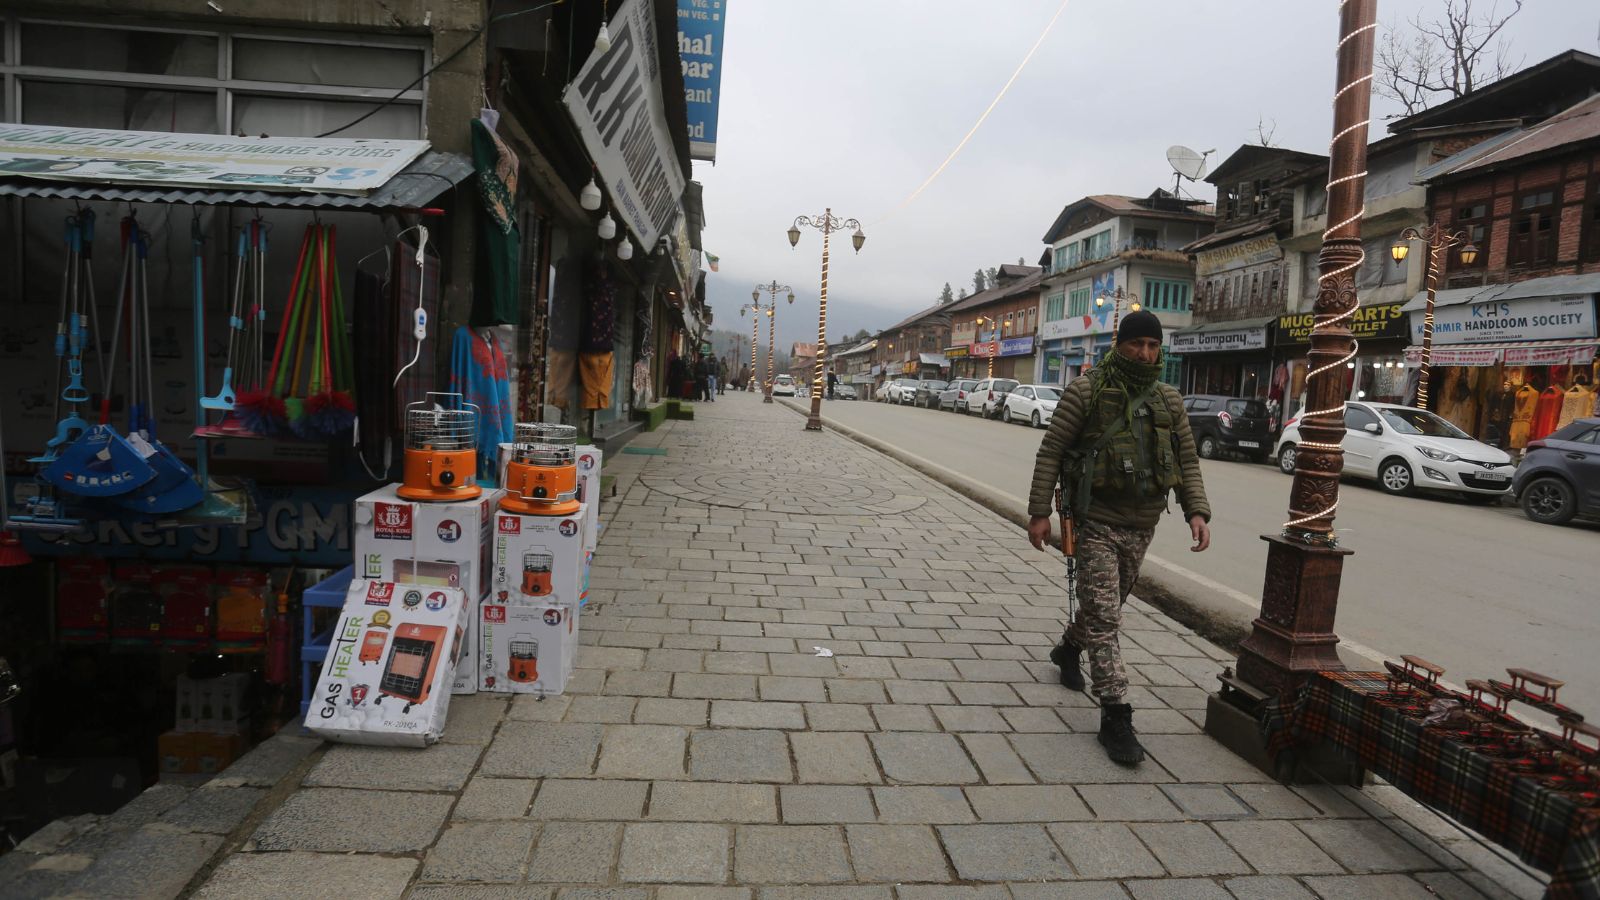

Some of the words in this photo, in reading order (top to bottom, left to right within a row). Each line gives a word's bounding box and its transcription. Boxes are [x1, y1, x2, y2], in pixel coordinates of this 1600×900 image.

[677, 9, 689, 18] ON
[677, 31, 713, 56] hal
[684, 87, 712, 104] ant
[0, 127, 169, 148] OCKERY
[174, 142, 314, 155] HARDWARE
[317, 147, 401, 158] STORE
[638, 155, 675, 233] FACTORY
[1245, 235, 1277, 253] SONS
[1280, 314, 1314, 329] MUG
[1289, 327, 1314, 337] FACT
[1349, 320, 1388, 332] UTLET
[1418, 322, 1462, 334] KSHMIR
[1465, 317, 1528, 331] HANDLOOM
[1532, 313, 1583, 327] SOCIETY
[1198, 331, 1247, 346] Company
[498, 566, 506, 583] GAS
[485, 653, 493, 670] GAS
[320, 683, 343, 719] GAS
